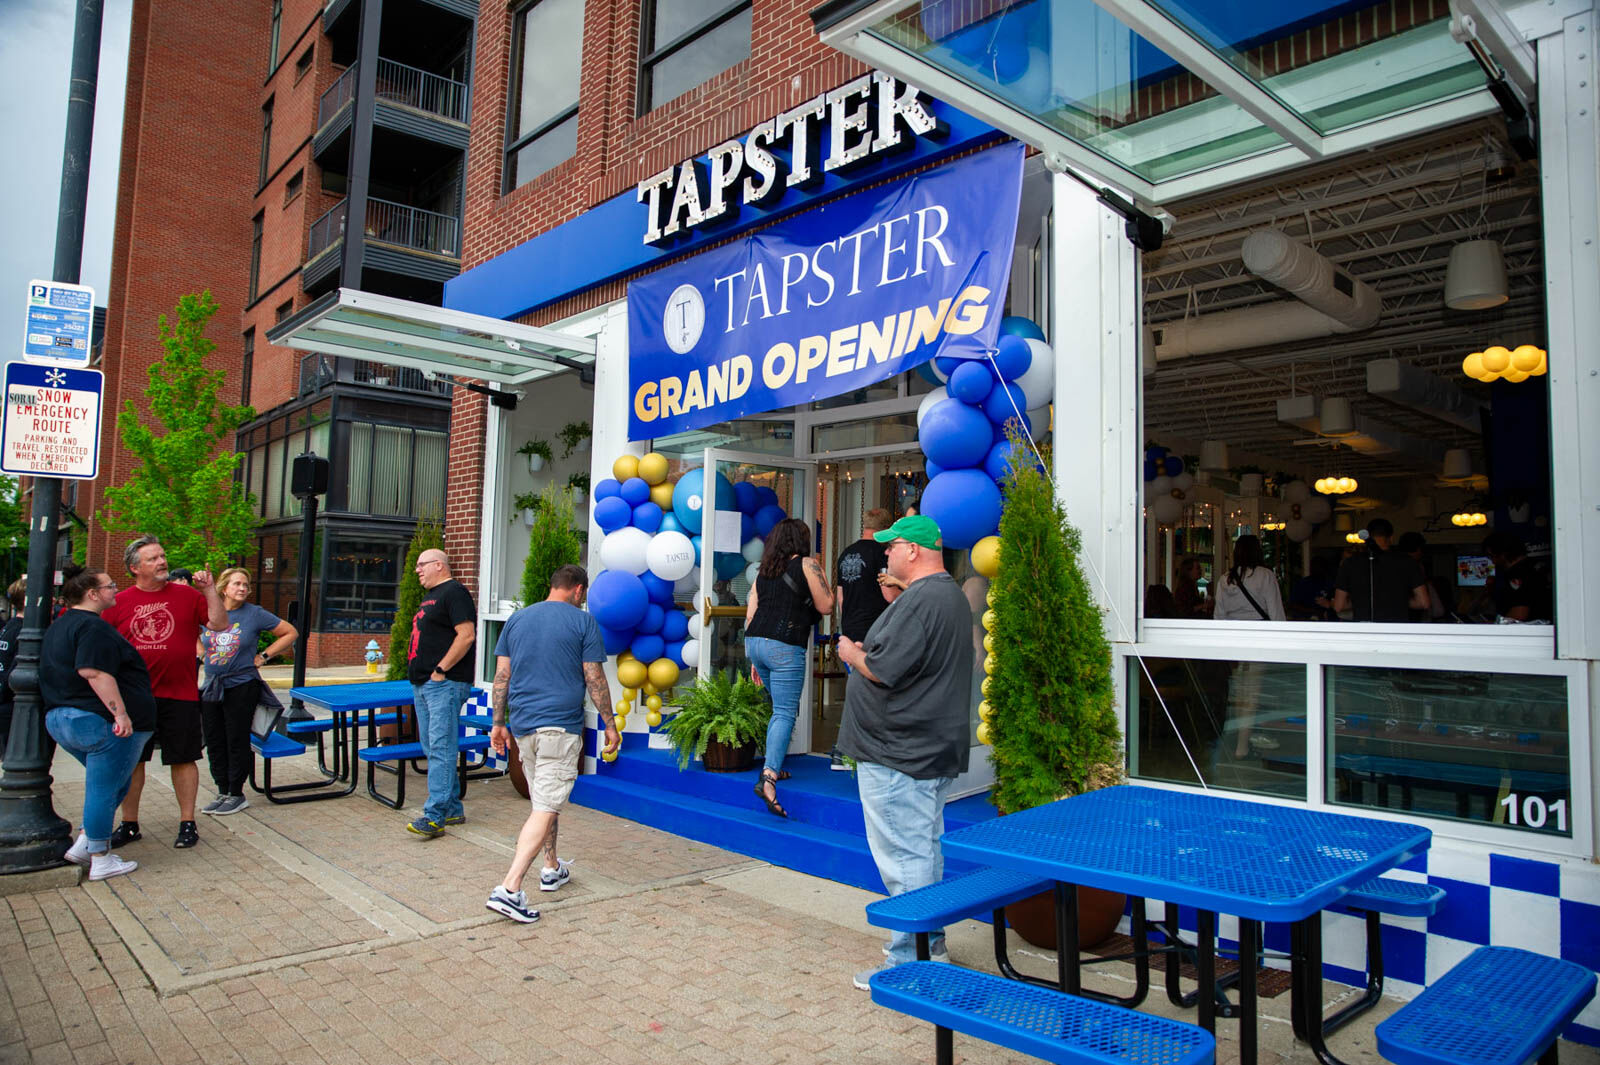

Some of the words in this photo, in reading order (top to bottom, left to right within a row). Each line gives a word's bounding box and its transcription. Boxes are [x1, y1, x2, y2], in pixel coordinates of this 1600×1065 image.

[637, 70, 937, 245] TAPSTER
[714, 204, 956, 333] TAPSTER
[34, 286, 44, 297] P
[633, 354, 753, 424] GRAND
[762, 285, 991, 390] OPENING
[37, 388, 72, 404] SNOW
[17, 404, 88, 420] EMERGENCY
[33, 418, 71, 433] ROUTE
[25, 434, 58, 444] PARKING
[62, 437, 77, 446] AND
[13, 442, 40, 452] TRAVEL
[45, 444, 88, 455] RESTRICTED
[16, 451, 36, 460] WHEN
[41, 453, 84, 463] EMERGENCY
[31, 462, 68, 472] DECLARED
[664, 552, 690, 564] TAPSTER
[134, 601, 169, 618] Miller
[1501, 793, 1567, 831] 101
